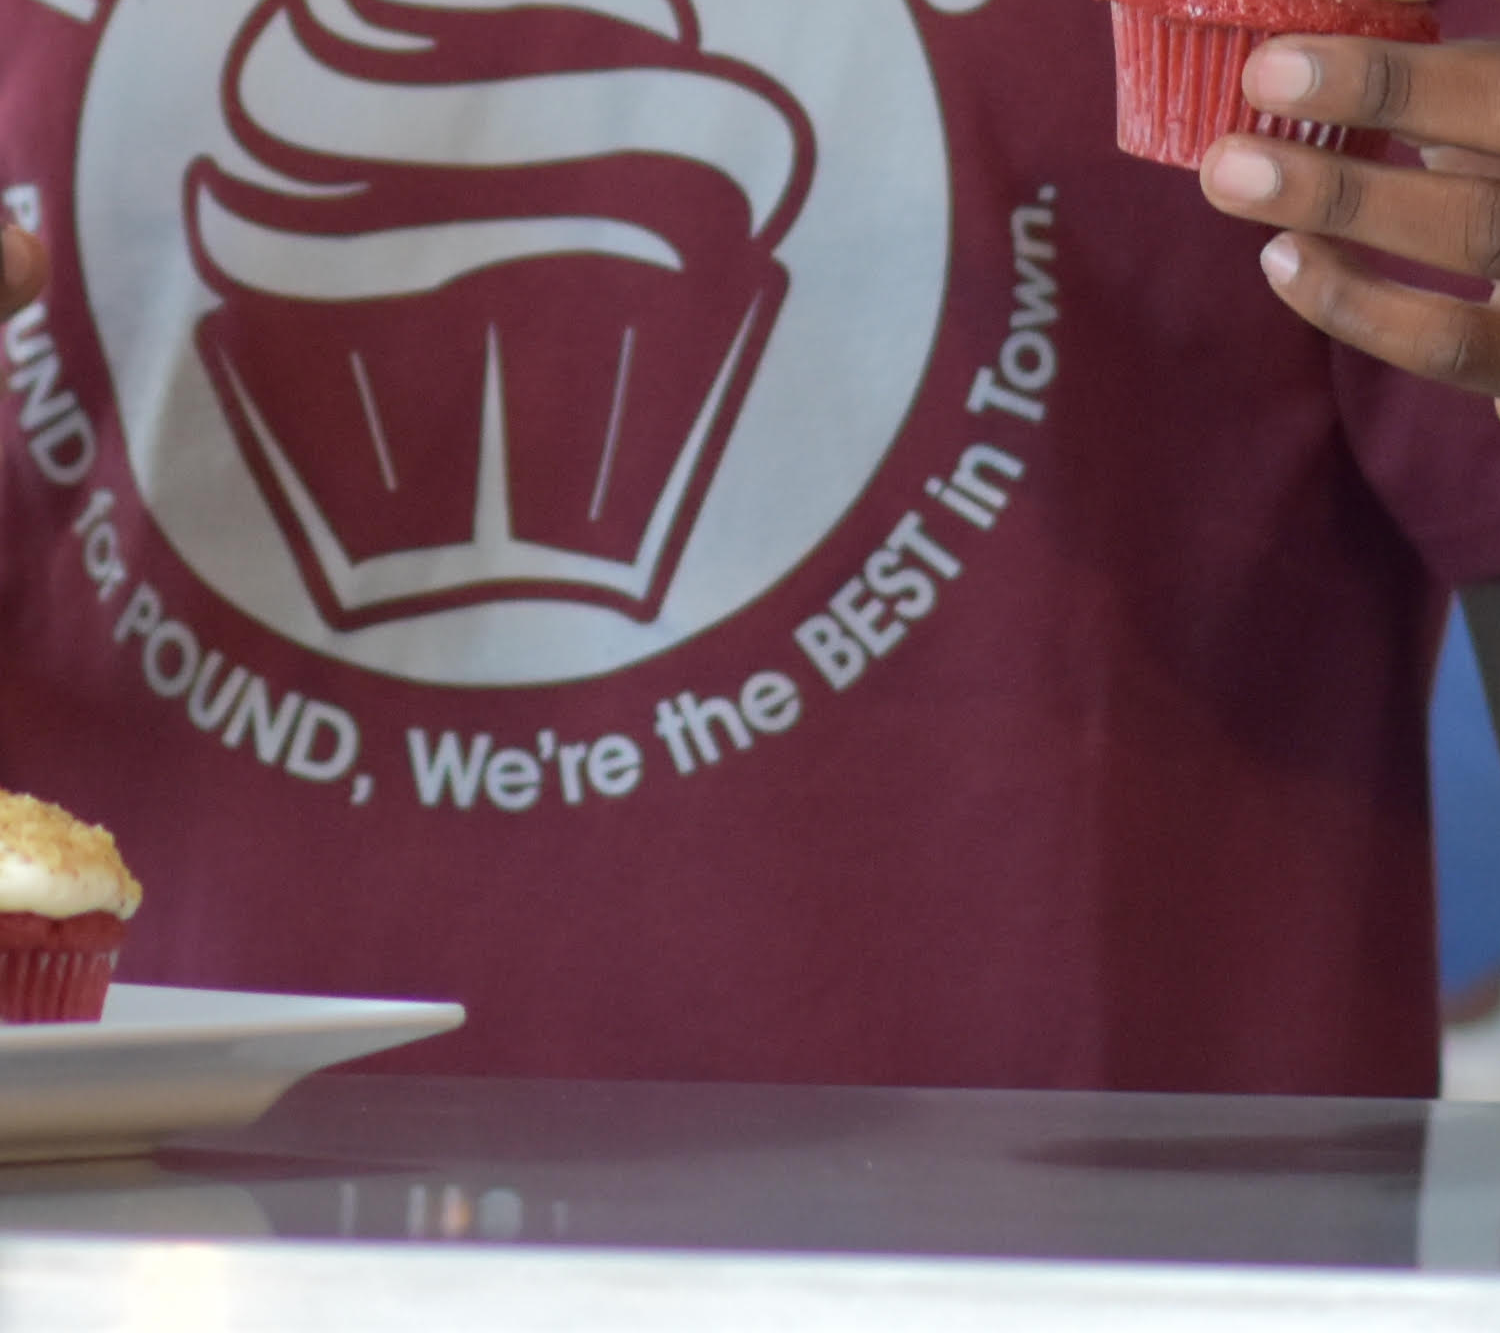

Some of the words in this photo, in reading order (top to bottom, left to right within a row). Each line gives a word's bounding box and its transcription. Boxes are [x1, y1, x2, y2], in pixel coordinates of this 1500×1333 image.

[2, 182, 97, 486] PUND
[965, 182, 1059, 423] Town.
[923, 442, 1026, 531] in
[793, 509, 964, 693] BEST
[113, 582, 374, 806] POUND,
[406, 727, 643, 812] We're
[655, 669, 803, 776] the
